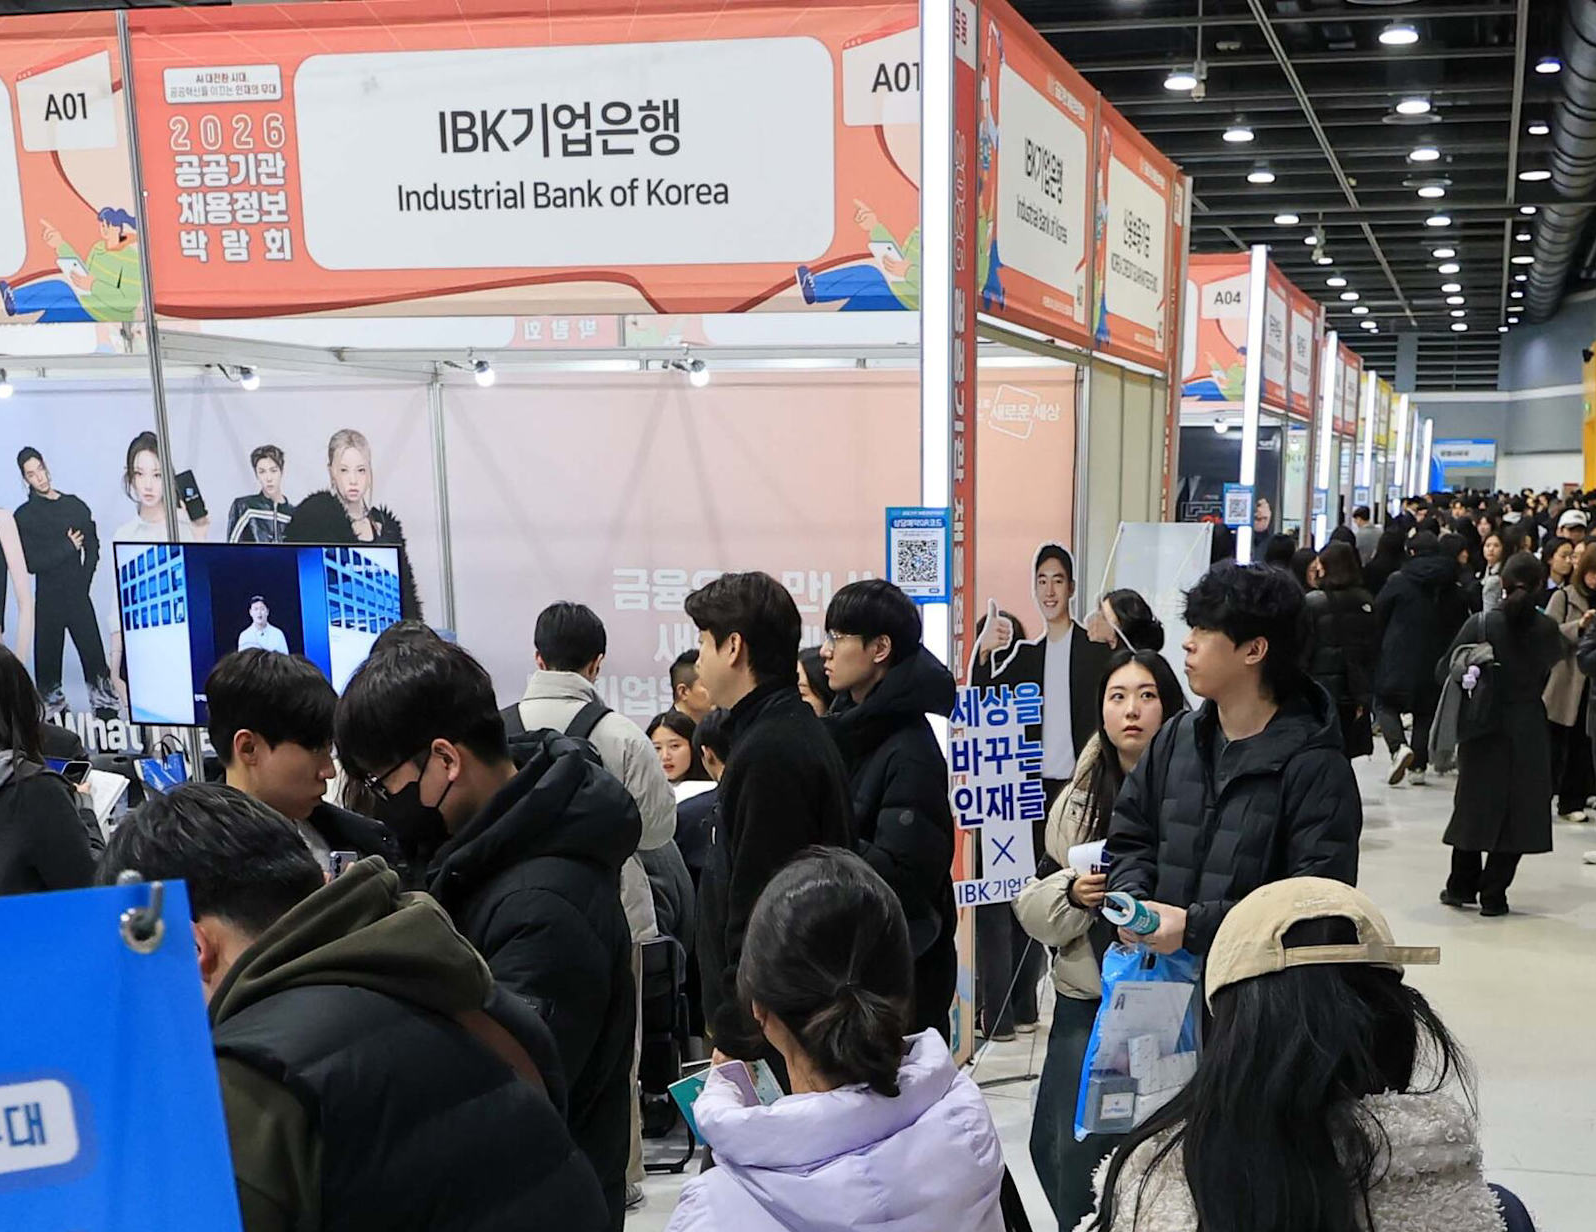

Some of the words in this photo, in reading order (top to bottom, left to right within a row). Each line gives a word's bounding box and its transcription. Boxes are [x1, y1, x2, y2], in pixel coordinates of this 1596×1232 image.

[871, 62, 920, 93] A01
[44, 92, 89, 122] A01
[168, 113, 286, 151] 2026
[438, 98, 681, 157] IBK기업은행
[174, 152, 286, 188] 공공기관
[178, 191, 290, 225] 채용정보
[397, 181, 525, 212] Industrial
[533, 180, 603, 208] Bank
[610, 178, 637, 206] of
[646, 178, 730, 206] Korea
[1214, 290, 1241, 305] A04
[950, 682, 1044, 729] 세상을
[951, 734, 1044, 776] 바꾸는
[954, 780, 1045, 827] 인재들
